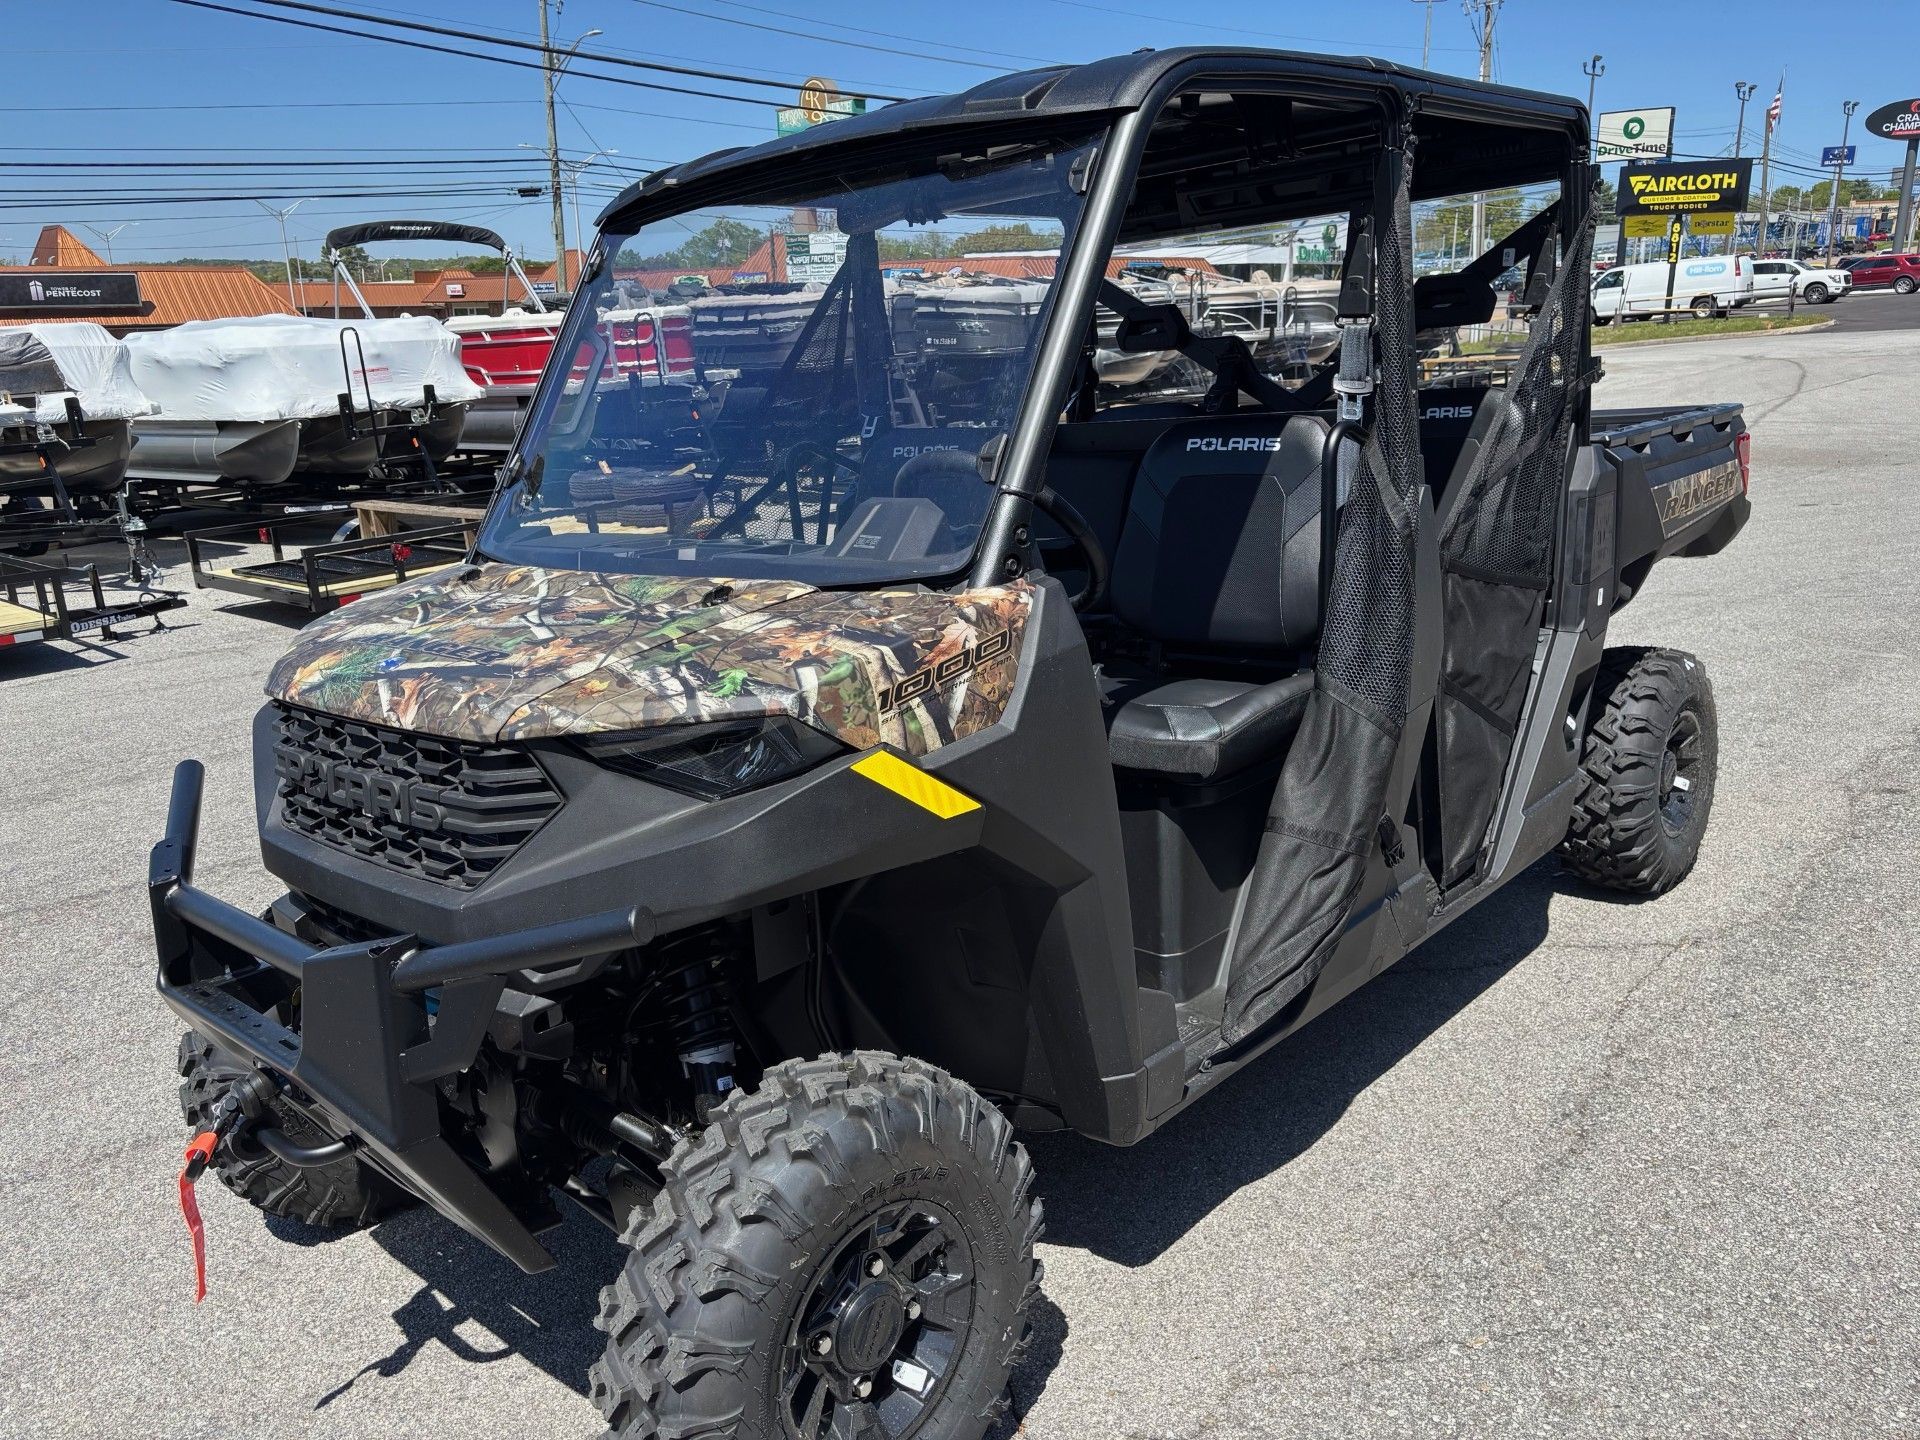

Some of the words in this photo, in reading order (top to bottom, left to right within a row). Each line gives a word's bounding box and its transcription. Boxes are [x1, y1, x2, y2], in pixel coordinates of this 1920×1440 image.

[1598, 142, 1666, 156] DriveTime
[1629, 172, 1738, 196] FAIRCLOTH
[1668, 222, 1680, 263] 8812
[46, 290, 102, 298] PENTECOST
[1419, 406, 1473, 419] LARIS
[1186, 437, 1281, 451] POLARIS
[1663, 470, 1736, 522] RANGER
[70, 615, 118, 633] ODESSA
[879, 626, 1012, 716] 1000
[989, 655, 1013, 671] CAM
[285, 746, 443, 832] POLARIS
